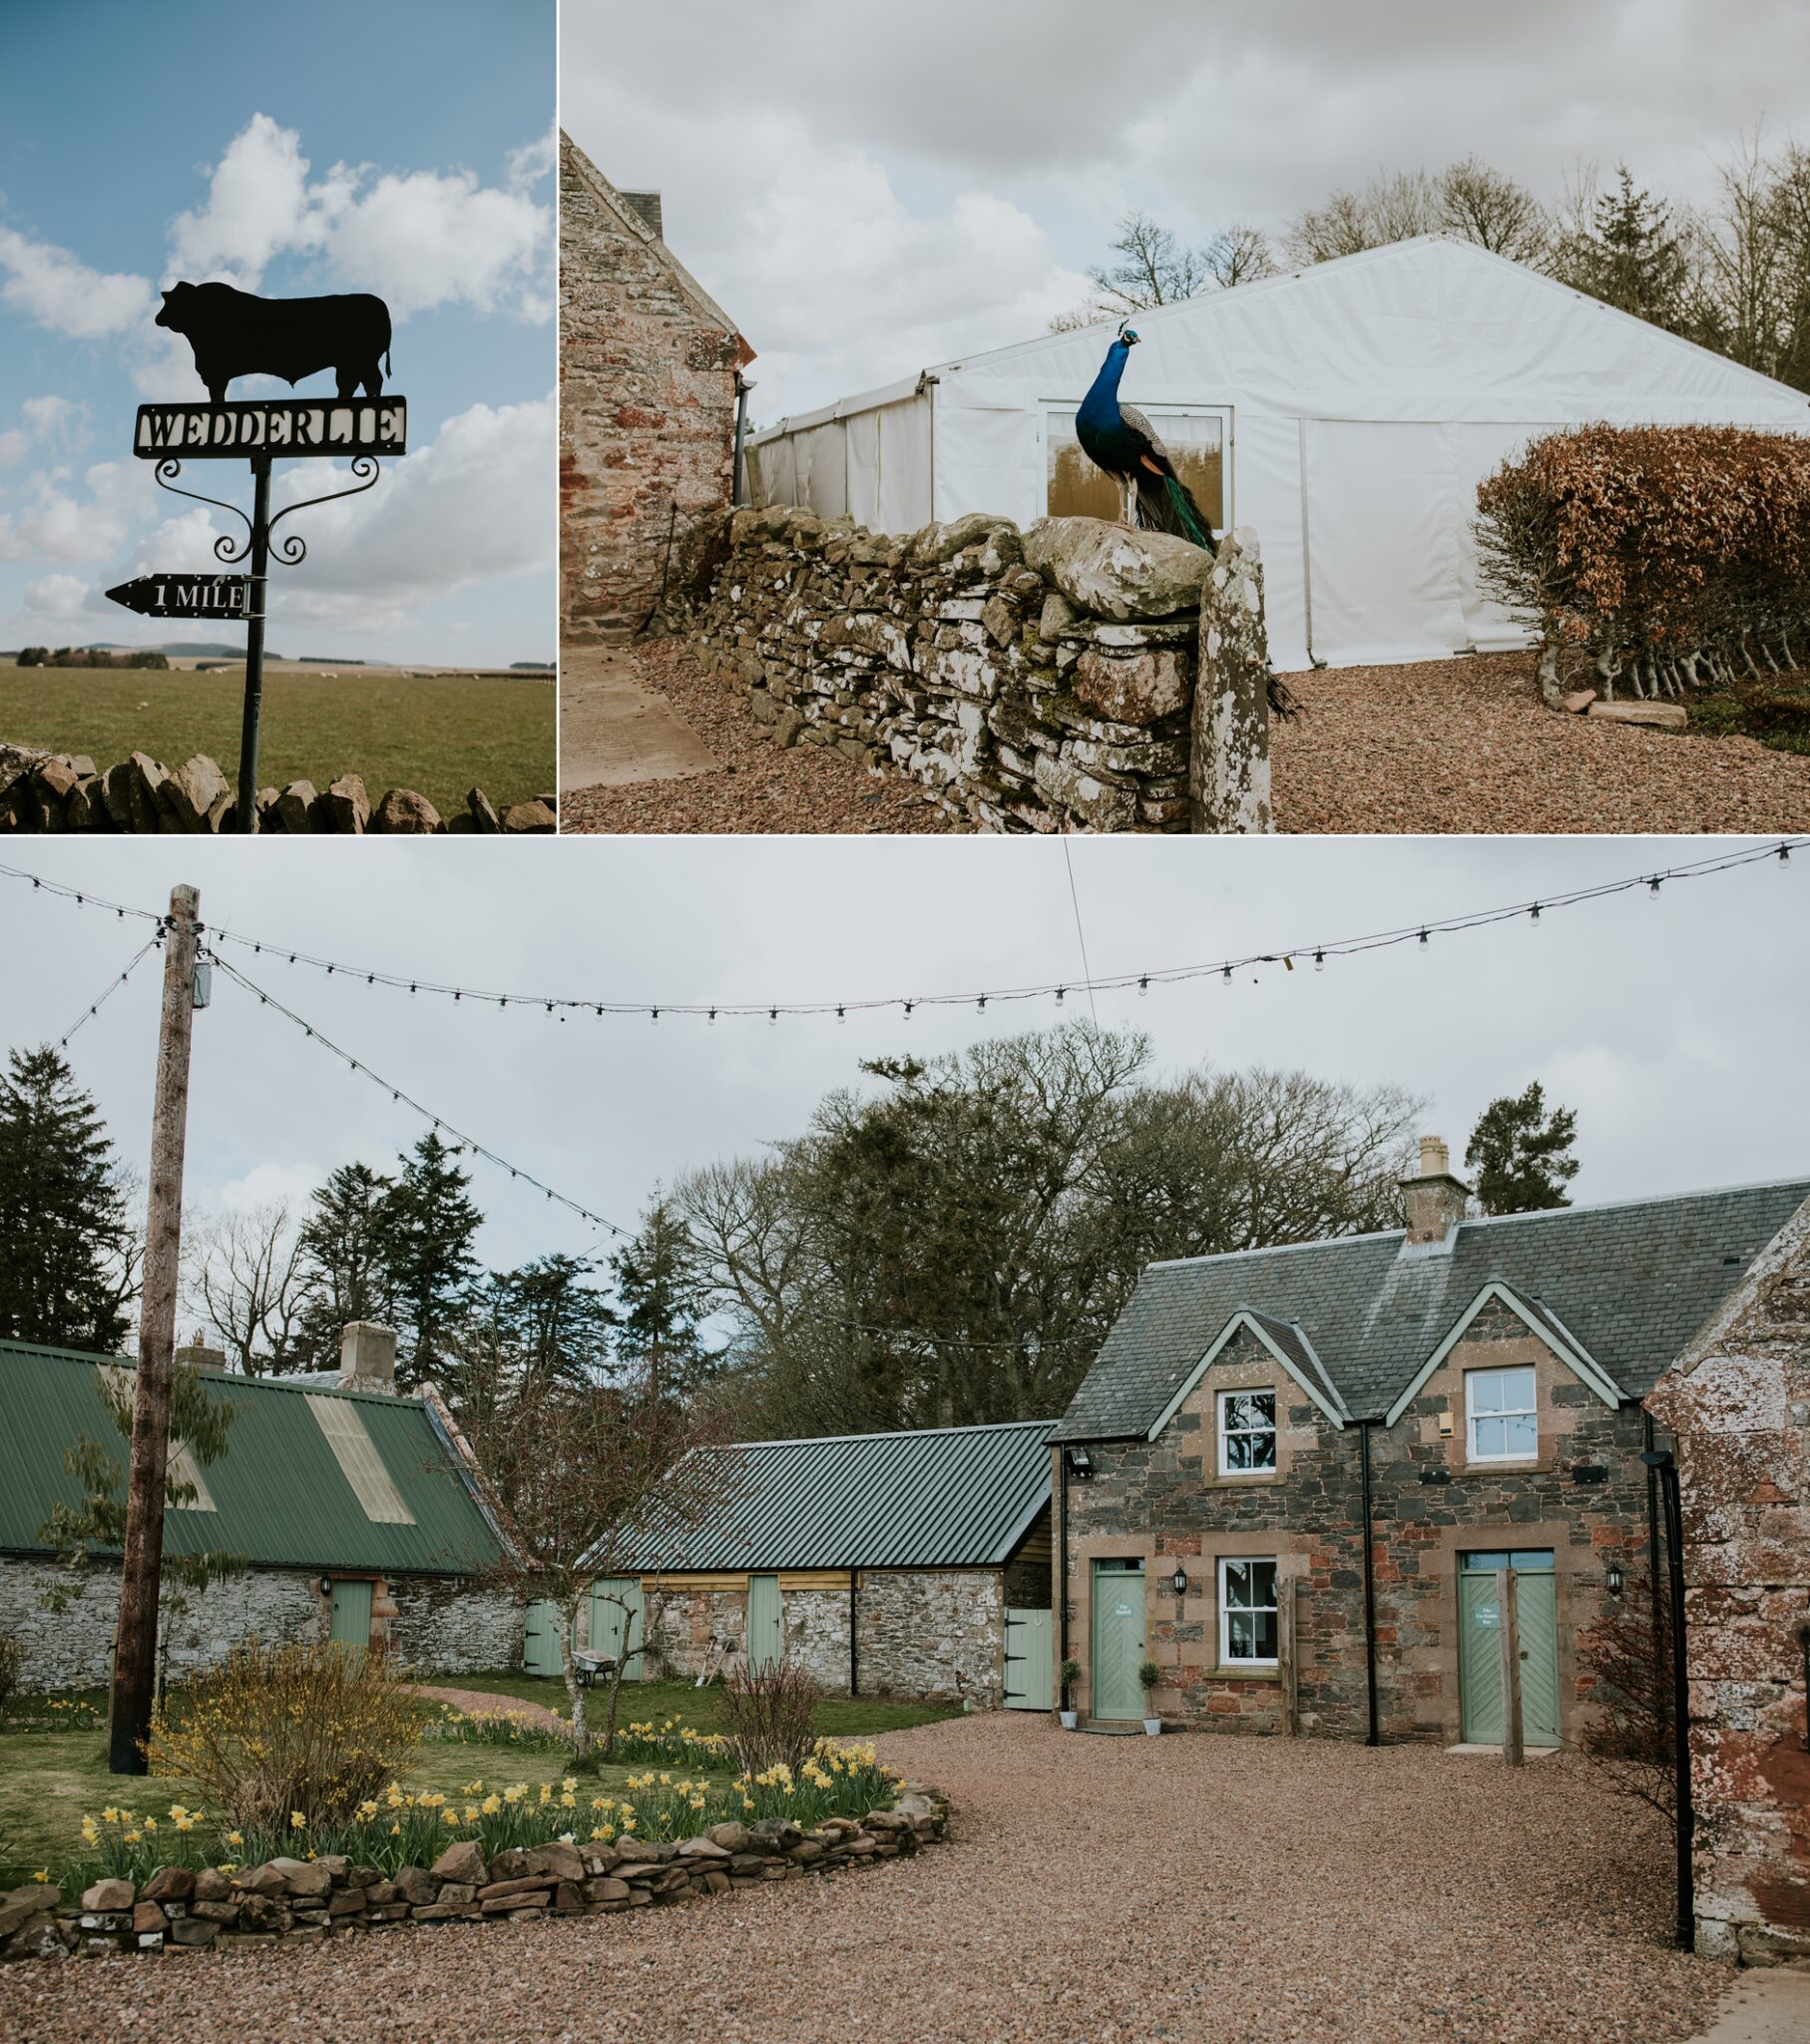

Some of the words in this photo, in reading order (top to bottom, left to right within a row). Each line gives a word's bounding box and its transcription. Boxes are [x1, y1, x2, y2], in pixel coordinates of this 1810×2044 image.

[147, 407, 399, 447] WEDDERLIE
[154, 584, 168, 607] 1
[176, 585, 244, 609] MILE
